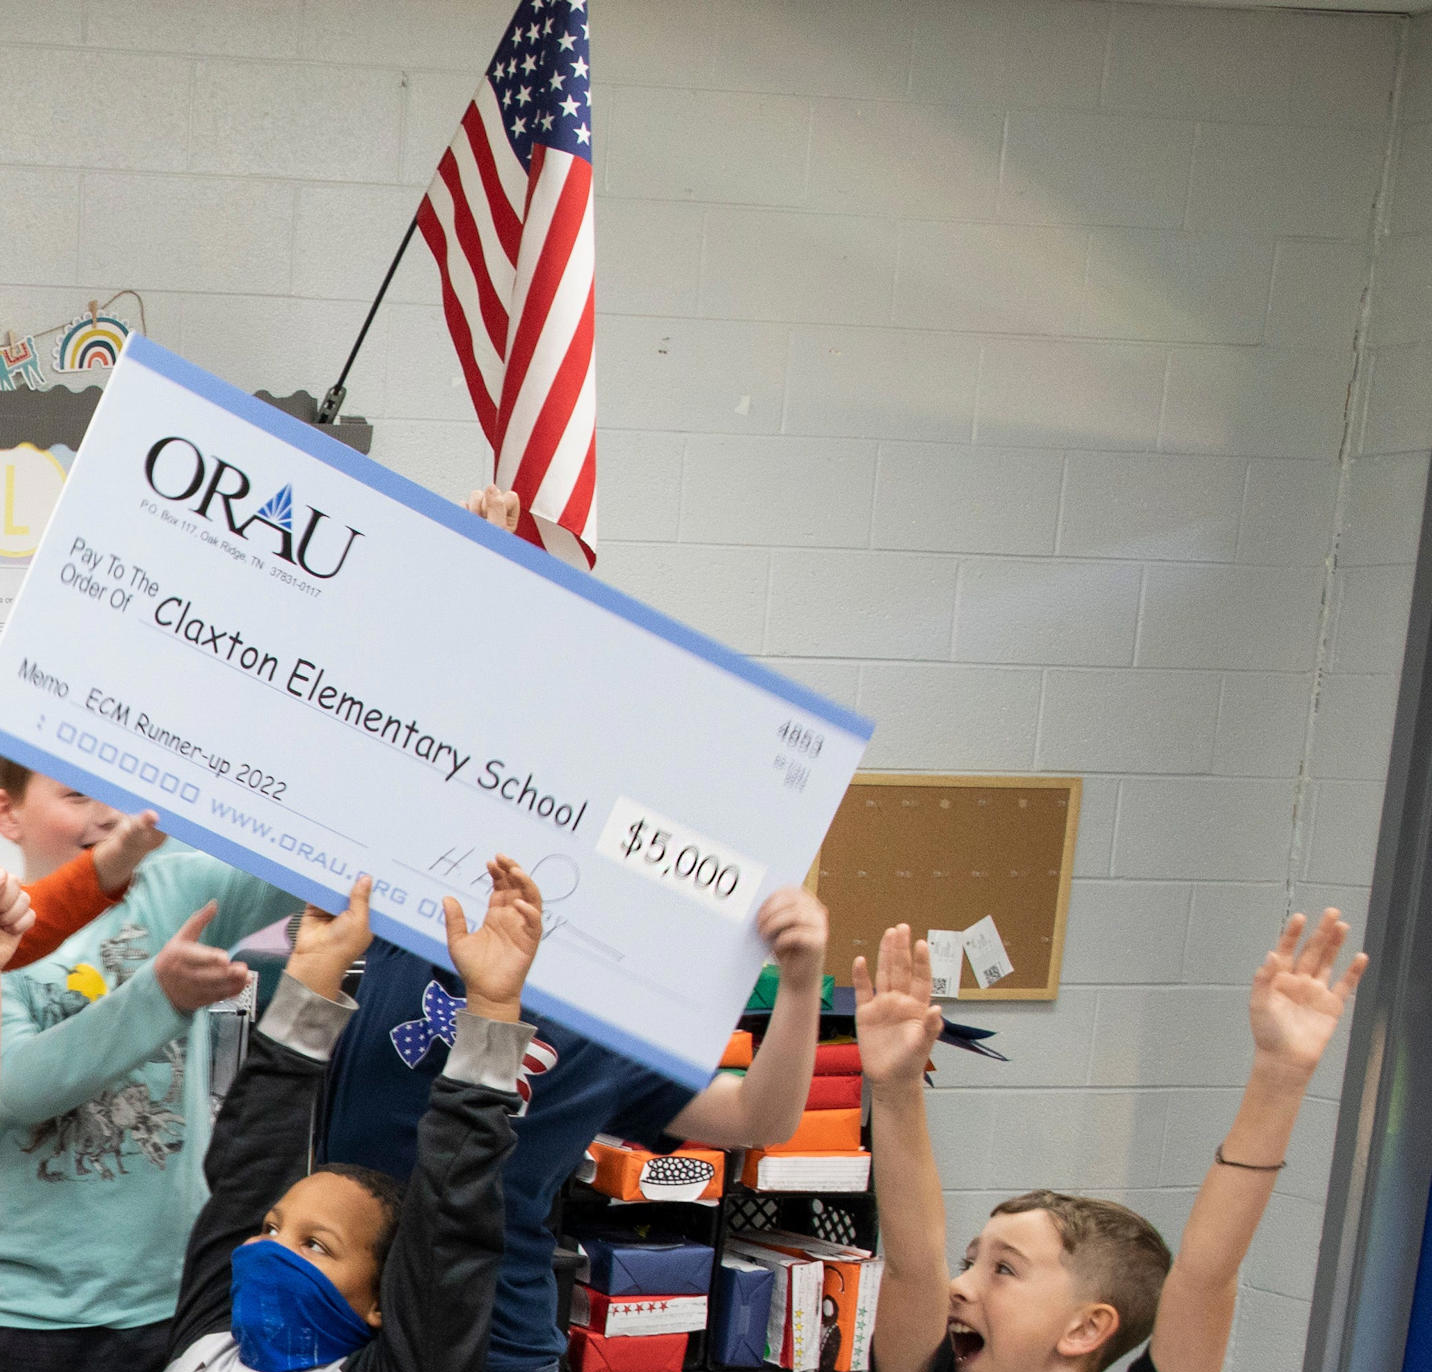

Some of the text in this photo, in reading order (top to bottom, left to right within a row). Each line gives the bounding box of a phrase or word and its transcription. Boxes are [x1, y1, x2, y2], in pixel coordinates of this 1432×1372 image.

[144, 437, 366, 579] ORAU
[161, 510, 178, 525] Box
[200, 531, 218, 546] Oak
[251, 556, 264, 571] TN
[60, 563, 134, 612] Order Of
[69, 537, 159, 598] Pay To The
[18, 657, 69, 699] Memo
[84, 687, 131, 727] ECM
[135, 712, 232, 777] Runner-up
[235, 763, 289, 801] 2022
[154, 596, 278, 683] Claxton
[286, 658, 471, 783] Elementary
[477, 759, 589, 832] School
[620, 815, 743, 900] $5,000
